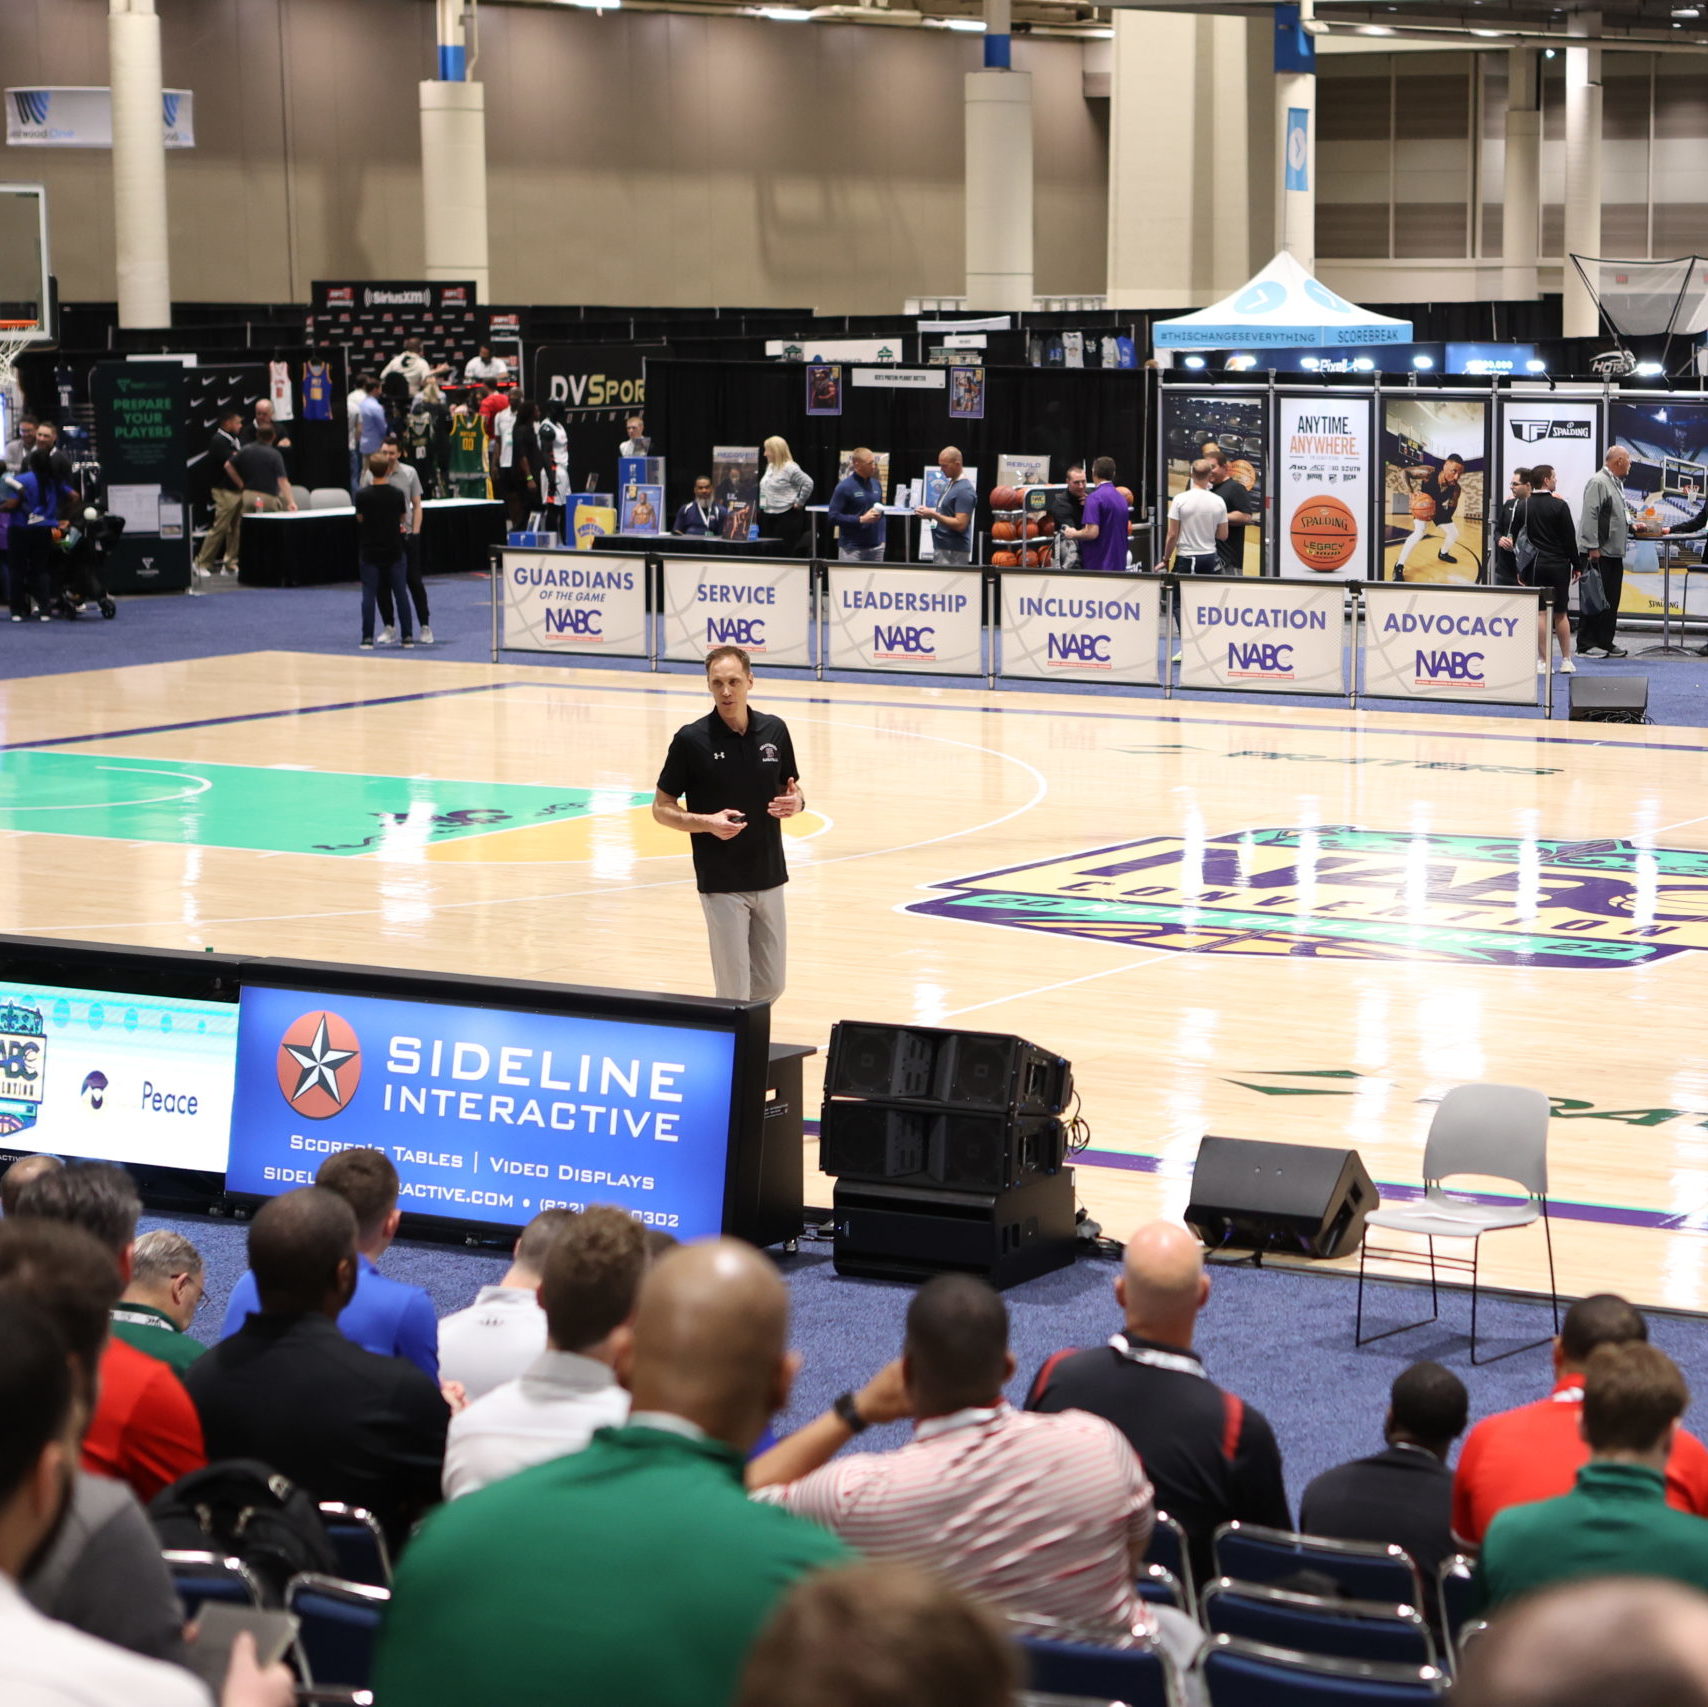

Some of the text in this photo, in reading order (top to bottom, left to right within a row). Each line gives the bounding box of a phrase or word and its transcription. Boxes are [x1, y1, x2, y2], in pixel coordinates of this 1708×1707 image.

[1161, 331, 1316, 343] #THISCHANGESEVERYTHING
[1338, 329, 1399, 344] SCOREBREAK
[551, 374, 645, 406] DVSPOR
[113, 398, 172, 411] PREPARE
[123, 413, 163, 424] YOUR
[1298, 415, 1352, 435] ANYTIME.
[115, 426, 172, 439] PLAYERS
[1552, 426, 1589, 438] SPALDING
[1289, 435, 1360, 455] ANYWHERE.
[1301, 516, 1348, 531] SPALDING
[1303, 540, 1345, 551] LEGACY
[513, 567, 634, 590] GUARDIANS
[539, 590, 606, 603] OF THE GAME
[697, 584, 776, 605] SERVICE
[843, 590, 967, 613] LEADERSHIP
[1648, 600, 1679, 609] SPALNG
[1019, 597, 1140, 621] INCLUSION
[1197, 606, 1326, 630] EDUCATION
[545, 608, 603, 635] NABC
[707, 617, 766, 645] NABC
[1383, 613, 1519, 637] ADVOCACY
[874, 625, 935, 653] NABC
[1048, 633, 1112, 662] NABC
[1228, 642, 1294, 672] NABC
[1416, 650, 1485, 681] NABC
[387, 1034, 685, 1103] SIDELINE
[142, 1080, 198, 1116] Peace
[383, 1083, 681, 1143] INTERACTIVE
